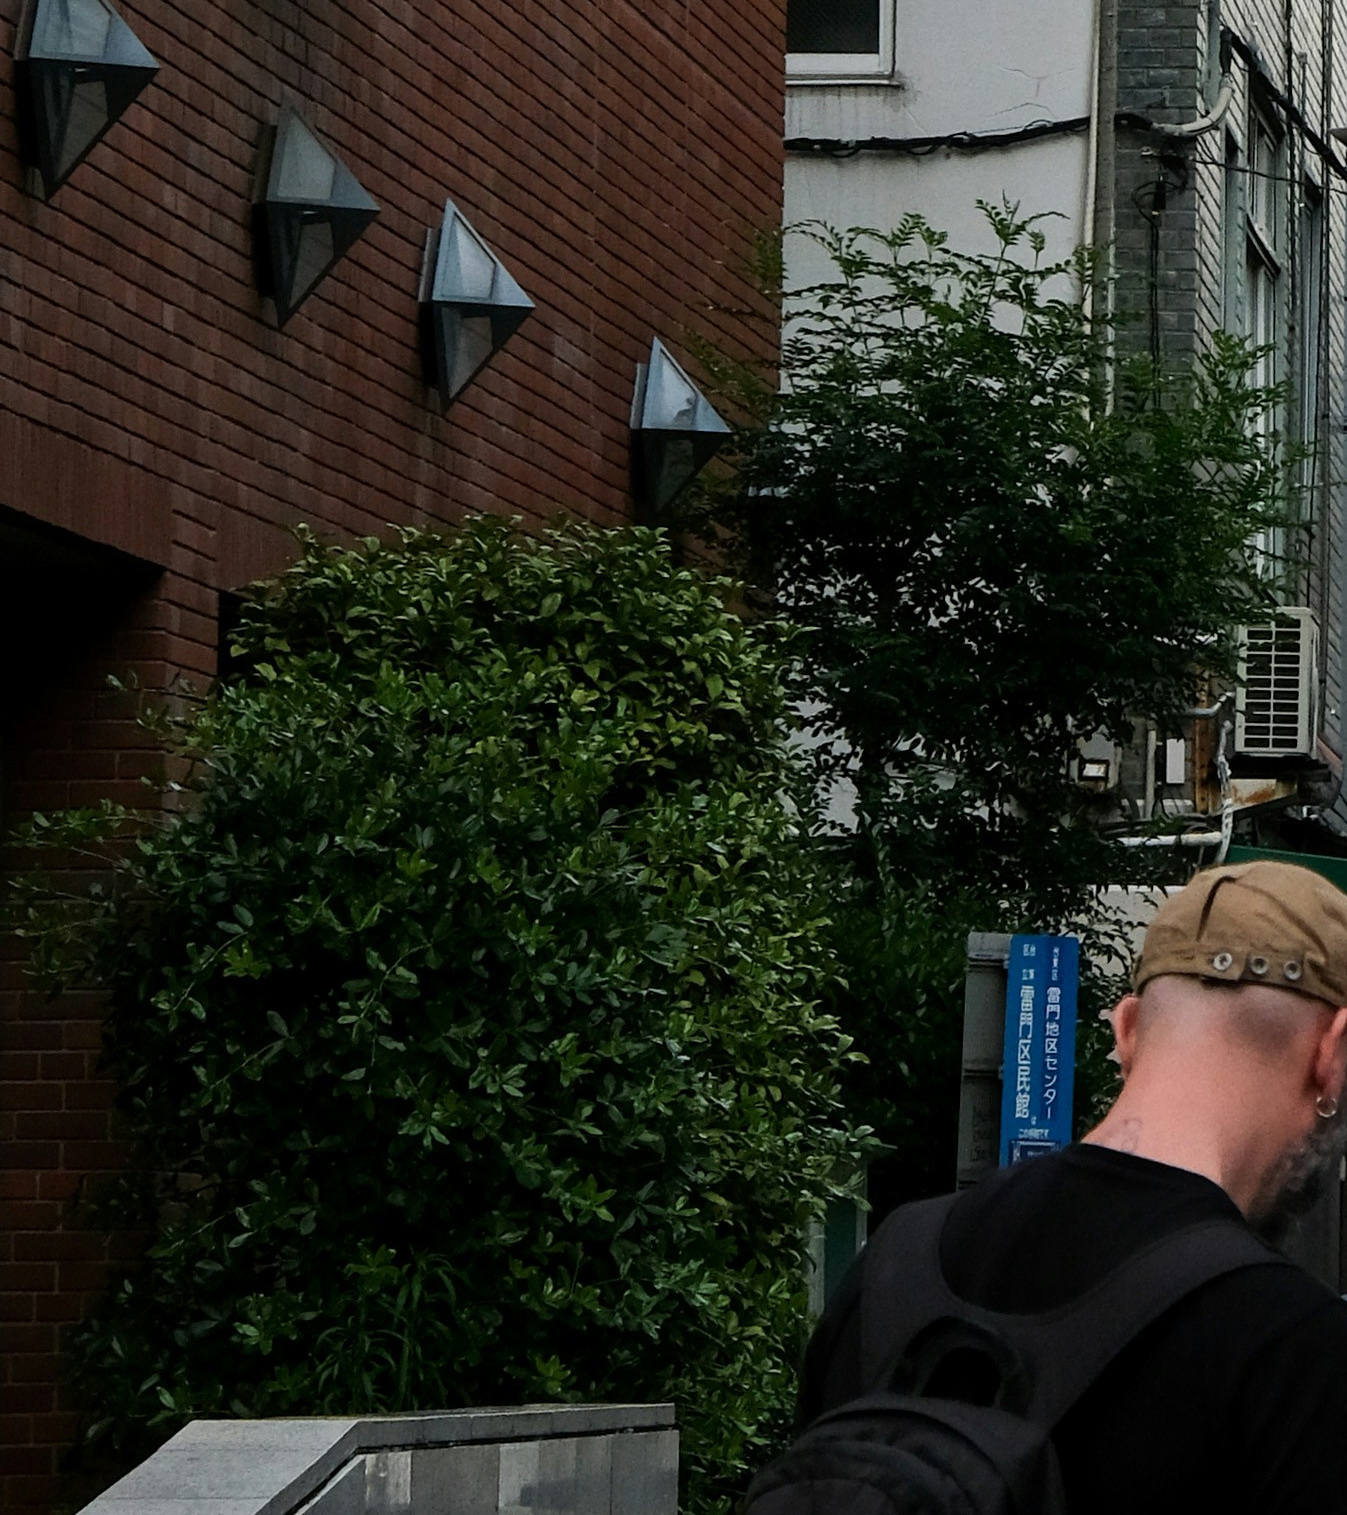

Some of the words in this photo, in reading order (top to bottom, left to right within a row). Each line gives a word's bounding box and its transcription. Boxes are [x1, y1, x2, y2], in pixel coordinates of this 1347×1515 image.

[1045, 987, 1061, 1119] 雷門地区センター
